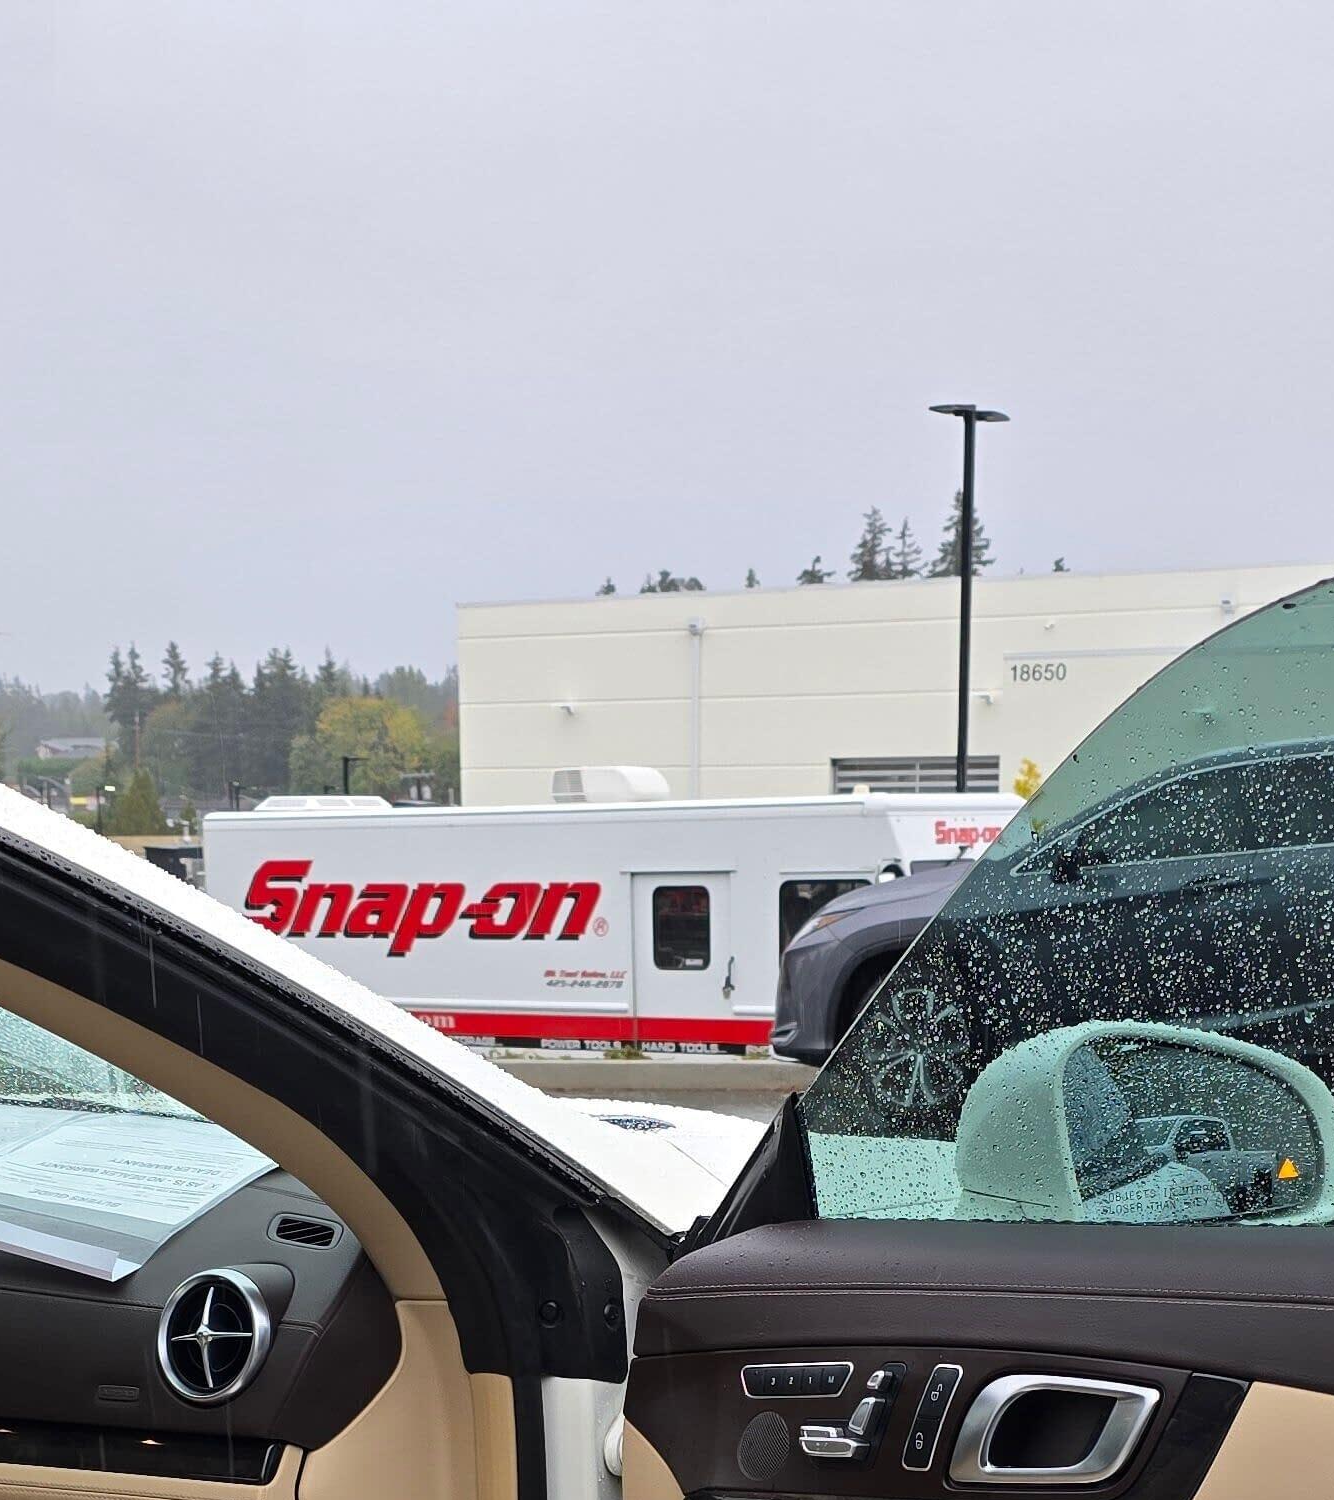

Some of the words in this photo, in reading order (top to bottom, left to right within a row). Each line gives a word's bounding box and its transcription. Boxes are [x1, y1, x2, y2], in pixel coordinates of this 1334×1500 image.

[1010, 662, 1067, 682] 18650
[244, 860, 602, 957] Snap-on
[541, 1038, 581, 1049] POWER
[641, 1041, 676, 1052] HAND
[37, 1161, 99, 1173] WARRANTY
[111, 1158, 172, 1171] WARRANTY
[101, 1170, 145, 1181] DEALER
[174, 1166, 221, 1176] DEALER
[1108, 1189, 1156, 1202] OBJECTS
[1150, 1200, 1177, 1212] THAN
